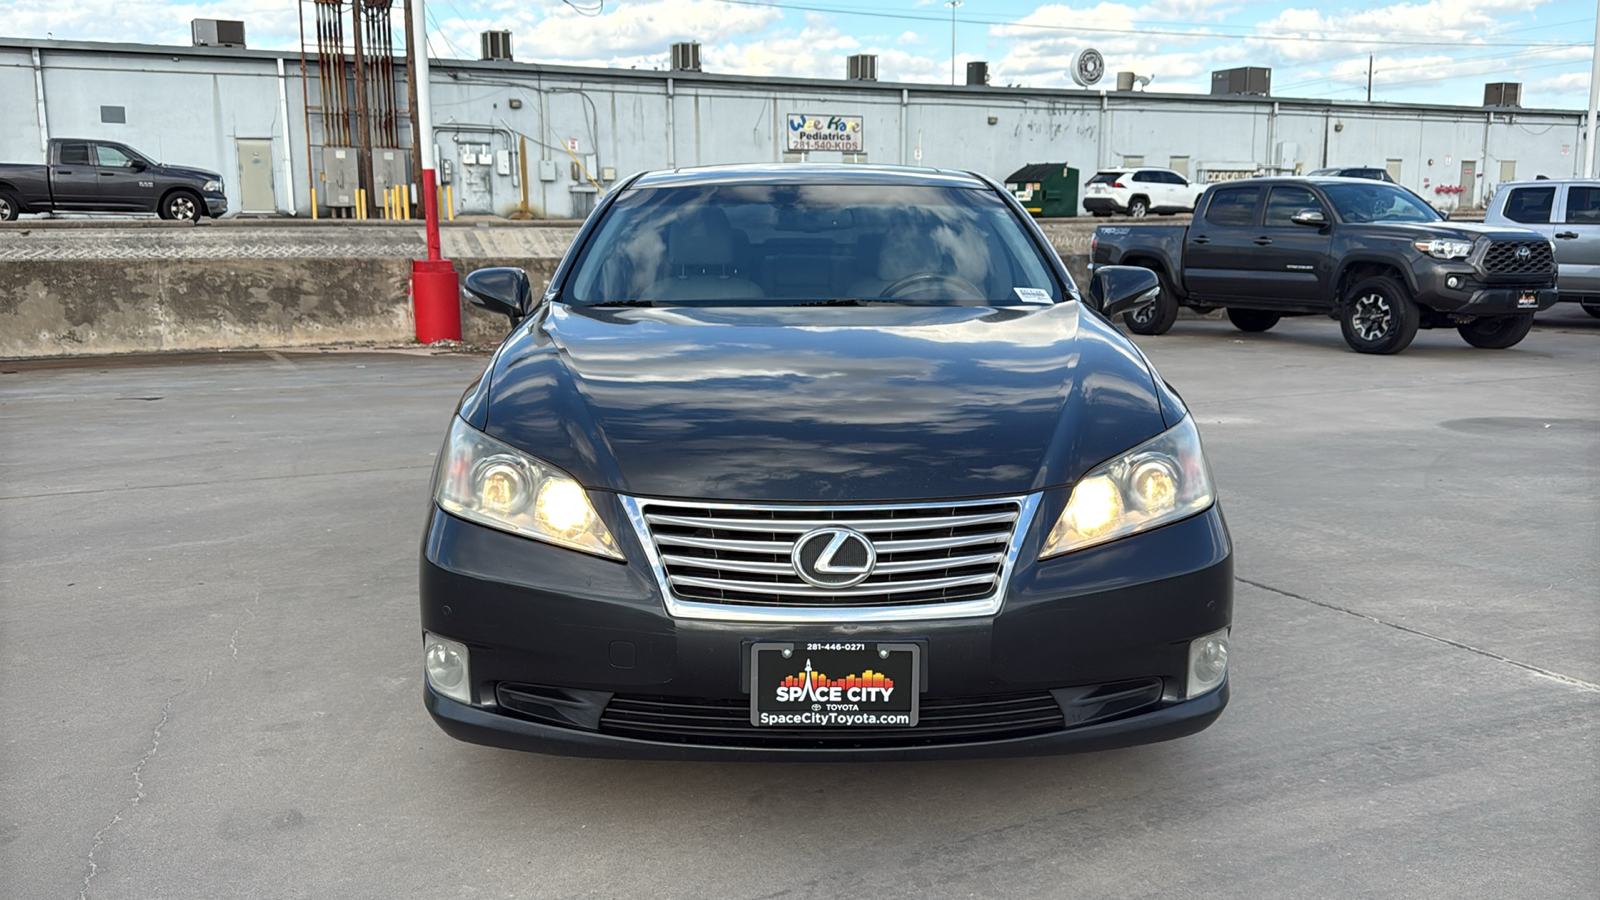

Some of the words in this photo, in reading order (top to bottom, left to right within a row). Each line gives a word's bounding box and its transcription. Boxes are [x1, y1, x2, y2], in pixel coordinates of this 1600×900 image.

[789, 114, 823, 131] Wee
[827, 115, 861, 133] Kare
[800, 131, 851, 140] Pediatrics
[793, 141, 858, 150] 281-540-KIDS
[806, 643, 865, 651] 281-446-0271
[776, 686, 842, 702] SPACE
[846, 686, 894, 702] CITY
[826, 703, 859, 711] TOYOTA
[760, 712, 909, 725] SpaceCityToyota.com
